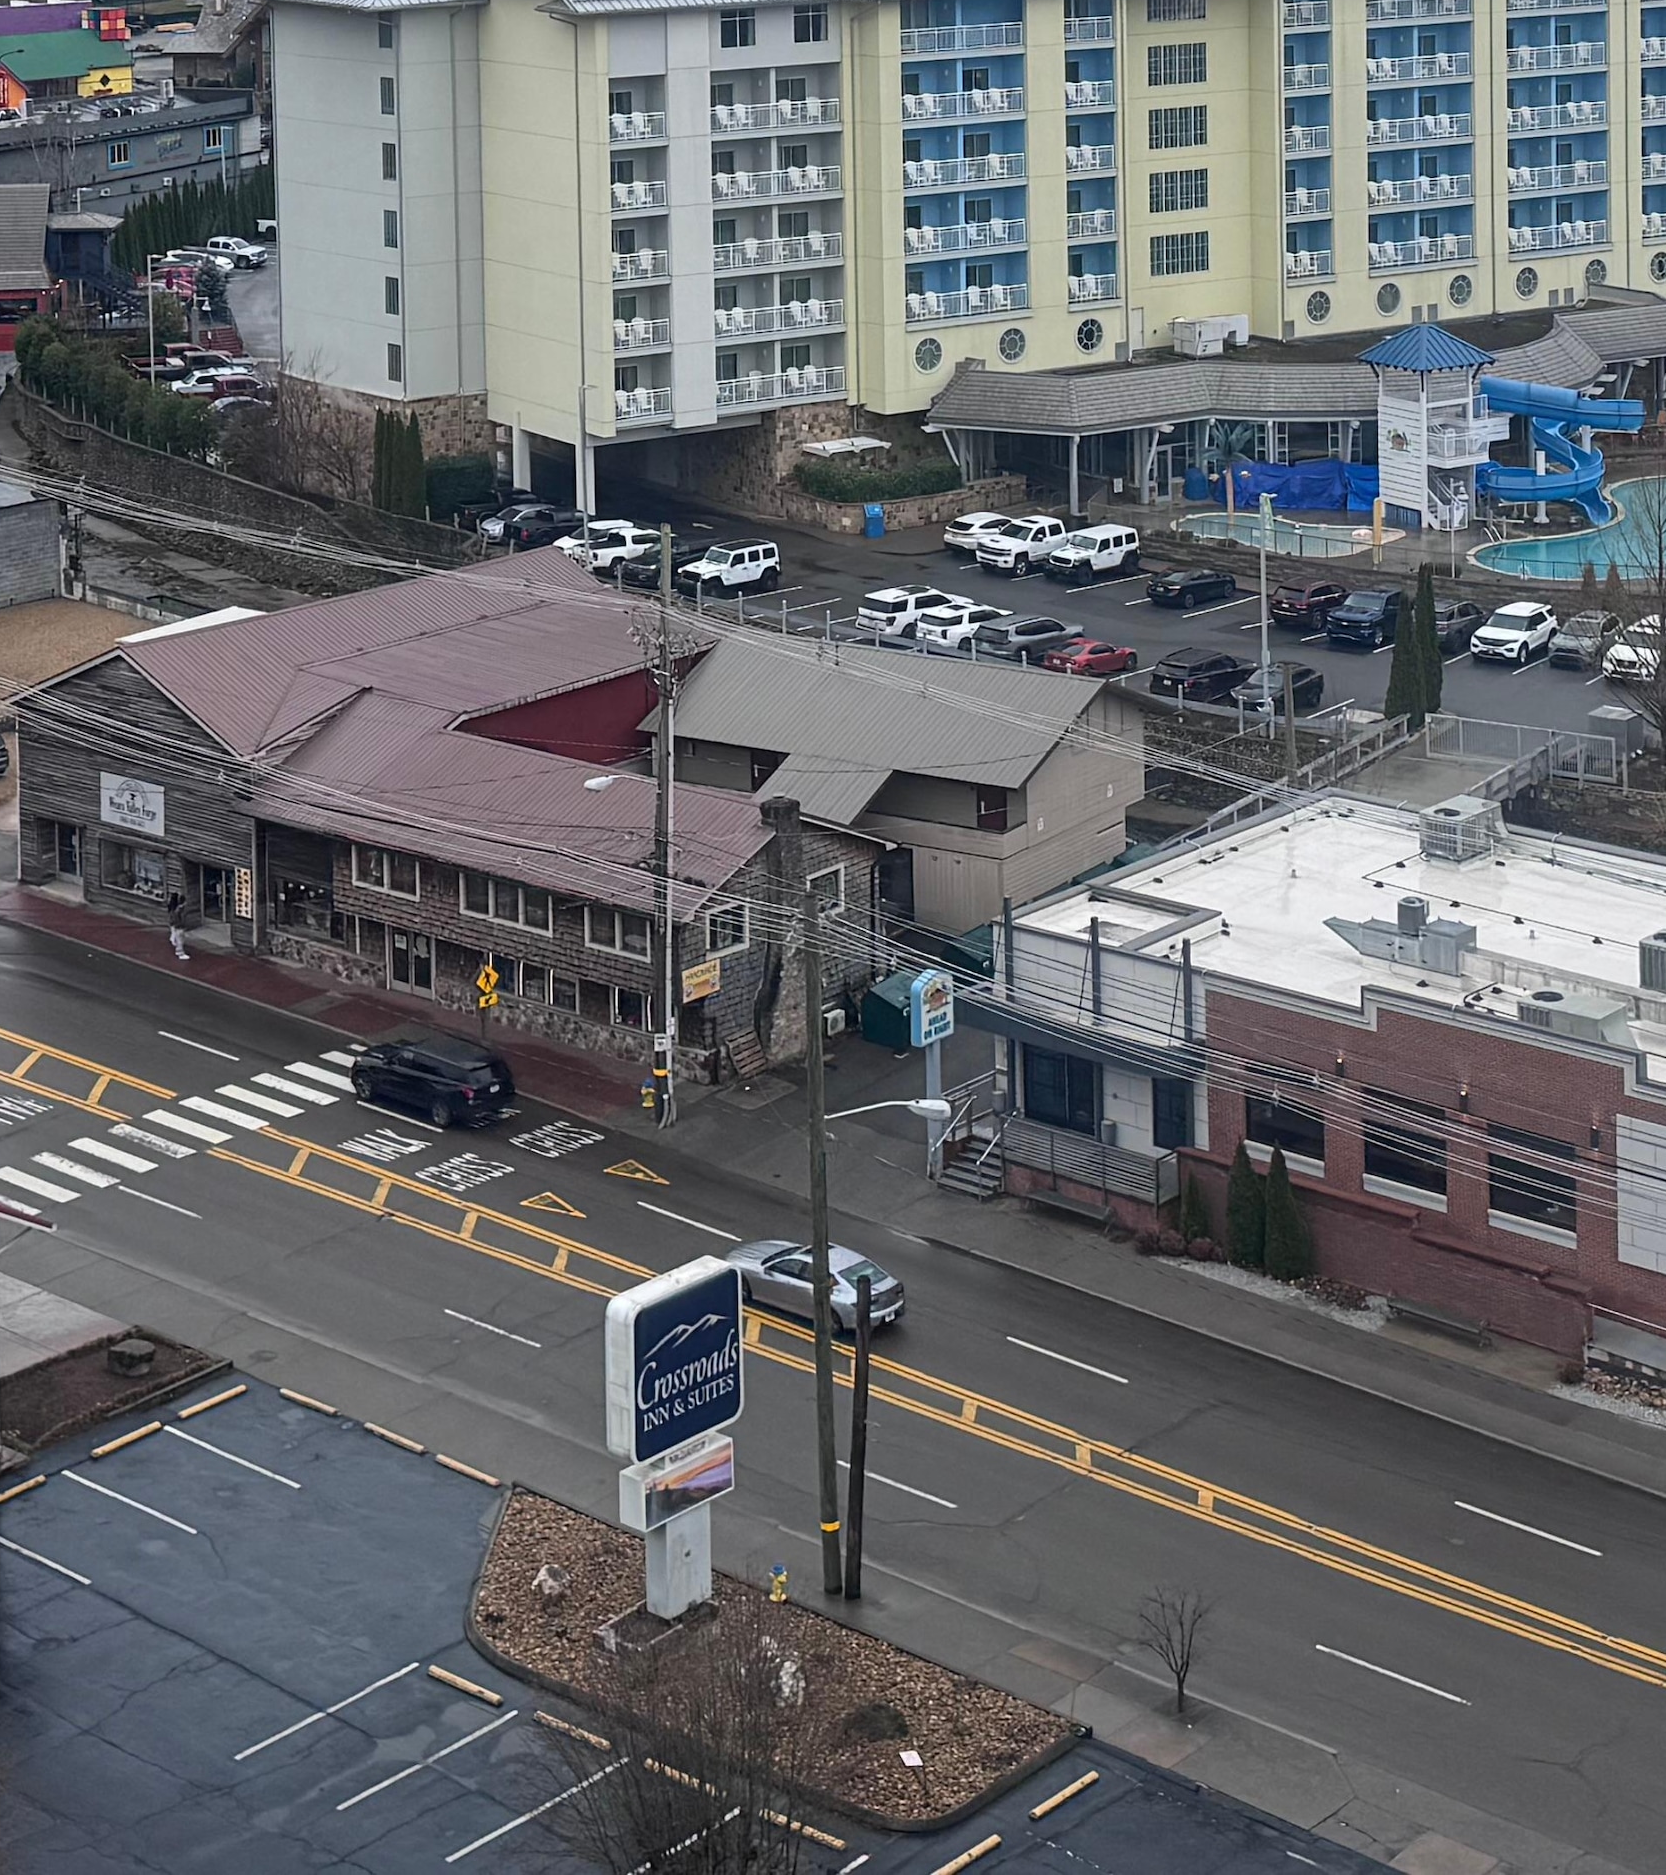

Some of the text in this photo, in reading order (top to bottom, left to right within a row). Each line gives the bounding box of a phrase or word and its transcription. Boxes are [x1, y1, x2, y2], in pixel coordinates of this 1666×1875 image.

[336, 1128, 433, 1162] WALK
[637, 1328, 739, 1411] Crossroads
[643, 1373, 735, 1432] INN & SUITES
